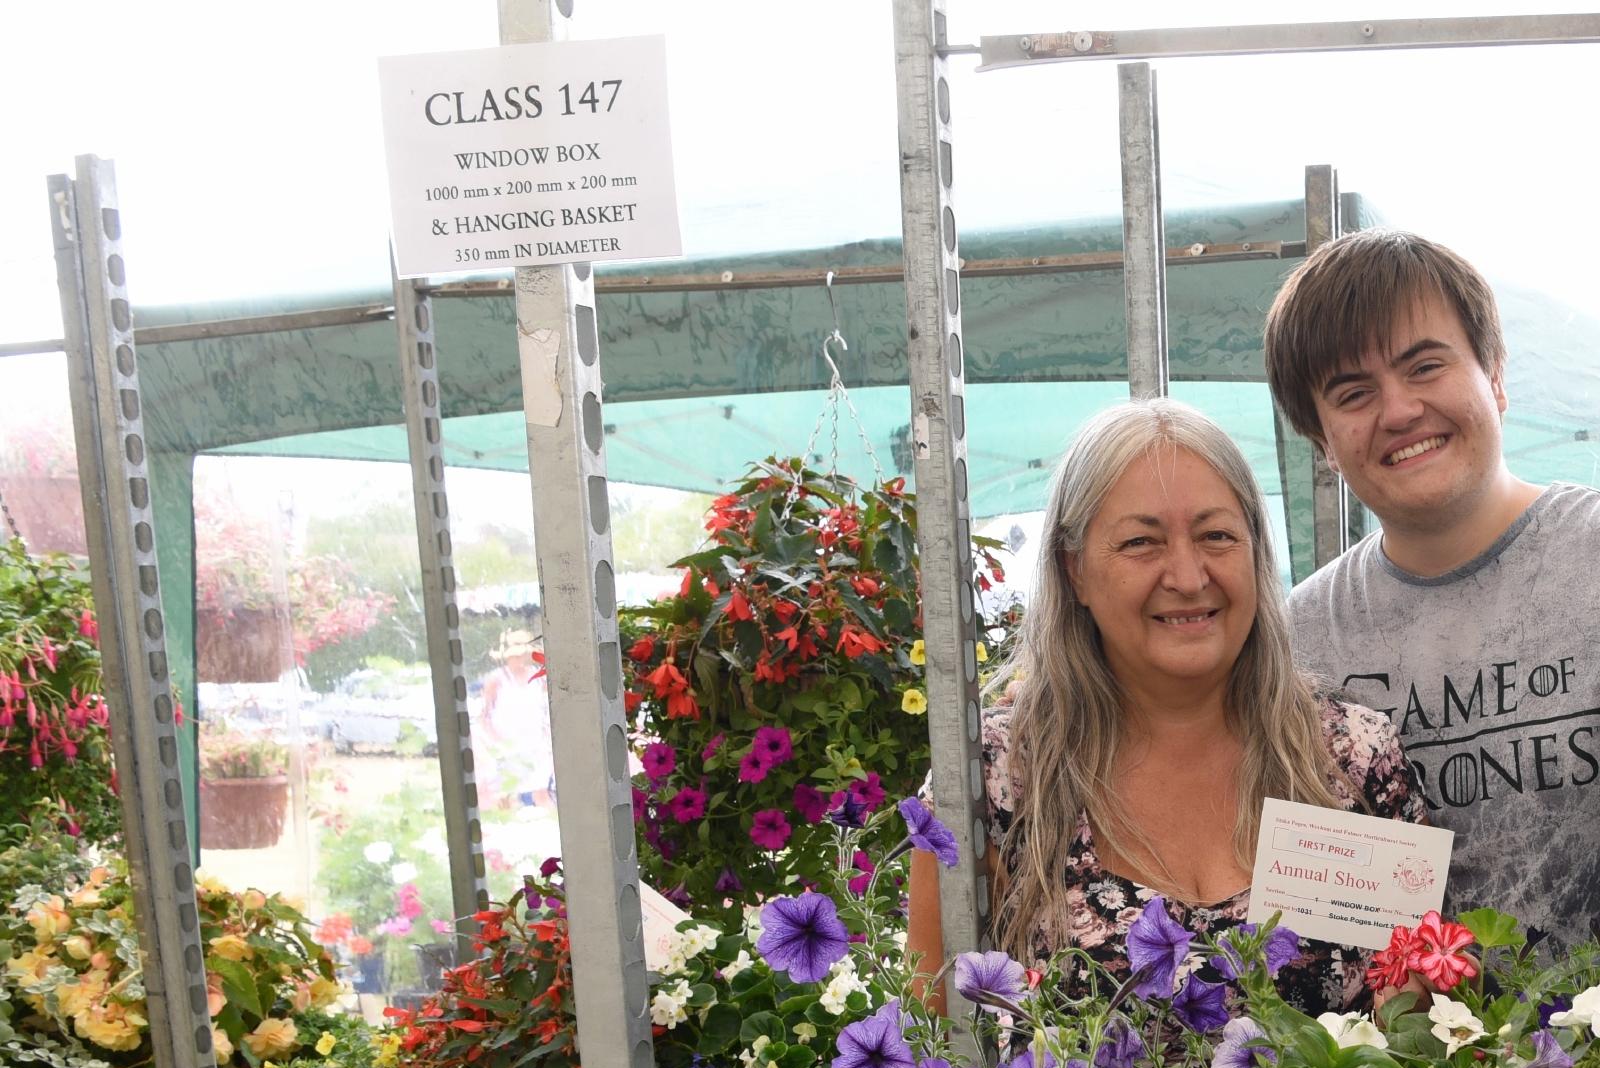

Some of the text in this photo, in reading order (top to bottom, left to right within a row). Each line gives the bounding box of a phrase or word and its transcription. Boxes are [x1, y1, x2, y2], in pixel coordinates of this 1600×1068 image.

[424, 80, 623, 126] CLASS 147
[454, 143, 601, 170] WINDOW BOX
[425, 174, 638, 202] 1000 mm x 200 mm x 200 mm
[432, 204, 638, 236] & HANGING BASKET
[455, 238, 622, 263] 350 mm IN DIAMETER
[1528, 657, 1576, 697] OF
[1298, 839, 1356, 858] FIRST PRIZE
[1268, 860, 1381, 892] Annual Show
[1328, 912, 1348, 922] Stoke
[1350, 916, 1372, 926] Poges
[1330, 899, 1363, 910] WINDOW
[1364, 905, 1380, 913] BOX
